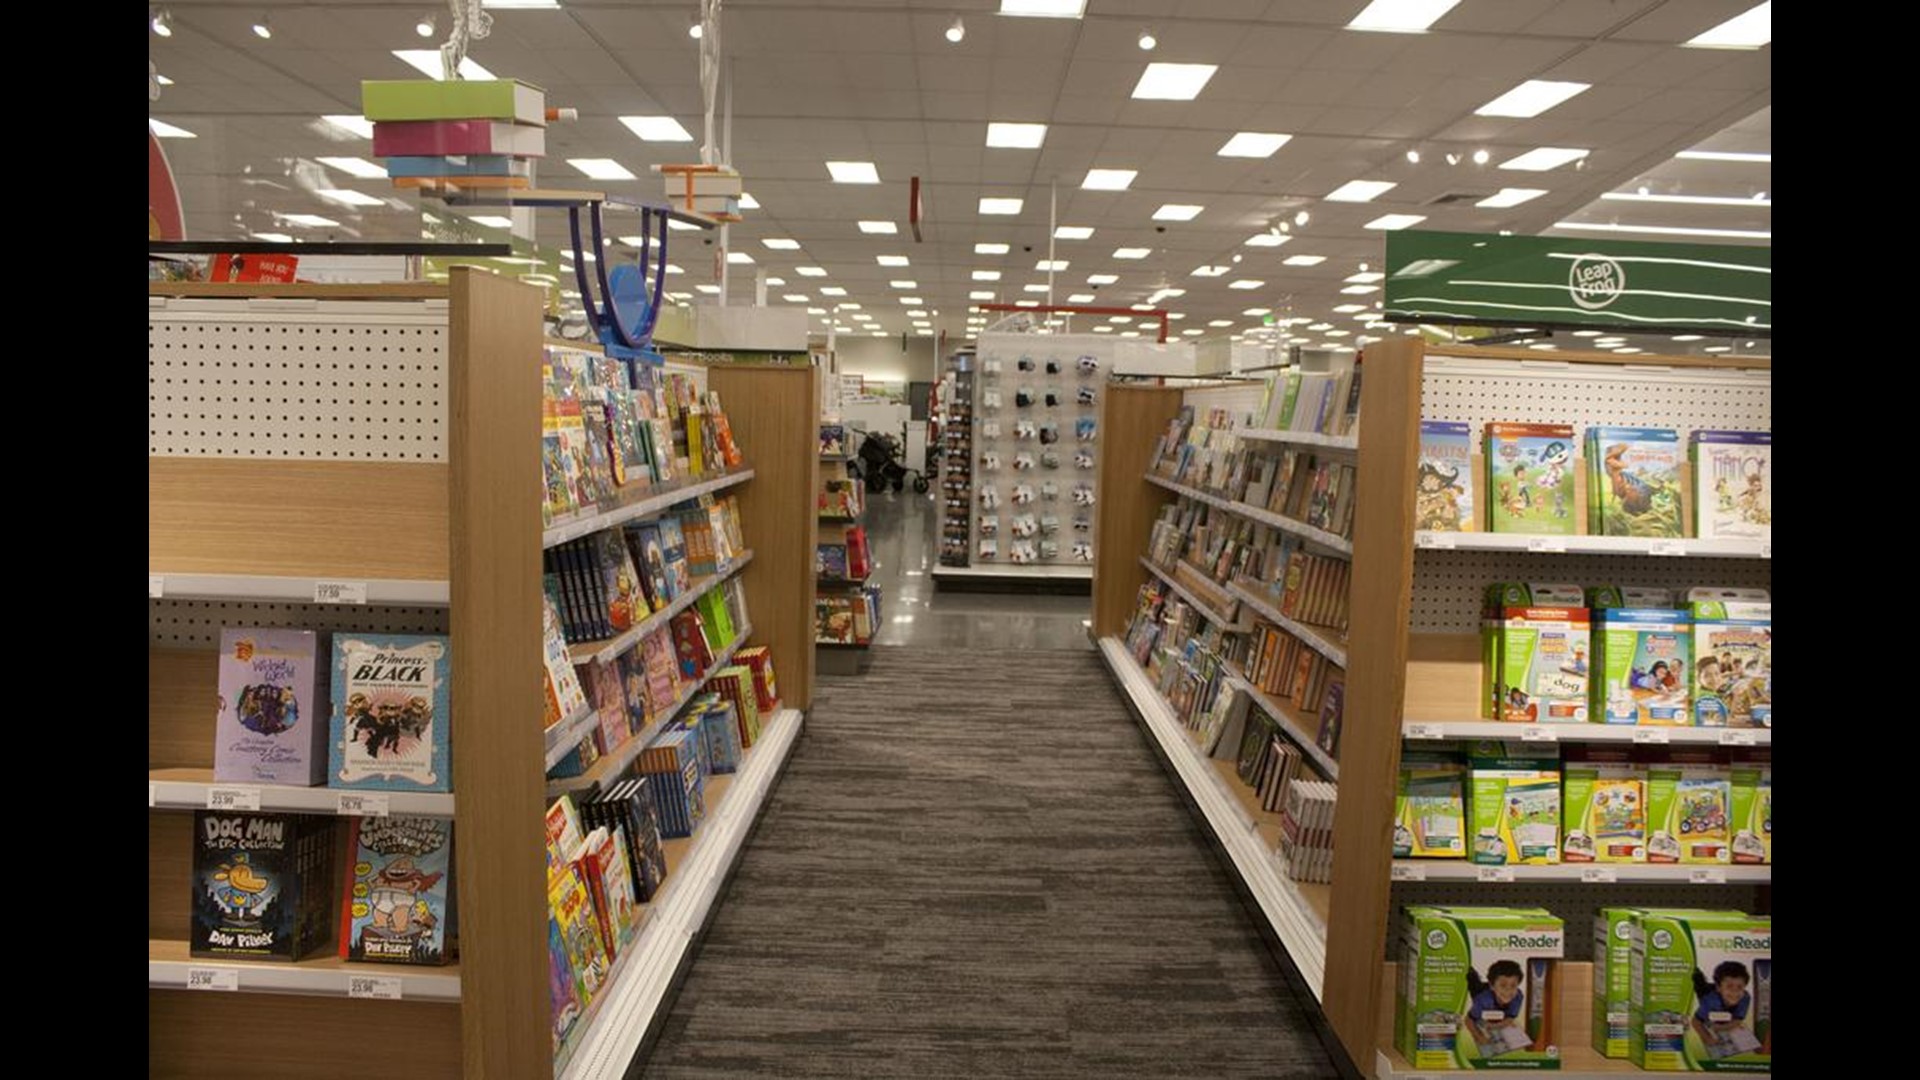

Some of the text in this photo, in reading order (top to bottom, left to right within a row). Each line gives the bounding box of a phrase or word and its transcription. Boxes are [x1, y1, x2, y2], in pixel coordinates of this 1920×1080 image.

[1576, 262, 1612, 283] Leap
[1580, 278, 1616, 298] Frog
[372, 652, 424, 664] Princess
[352, 664, 426, 682] BLACK
[1554, 679, 1580, 693] dog
[204, 816, 284, 842] DOG MAN
[208, 929, 235, 947] DAV
[1474, 934, 1560, 951] LeapReader
